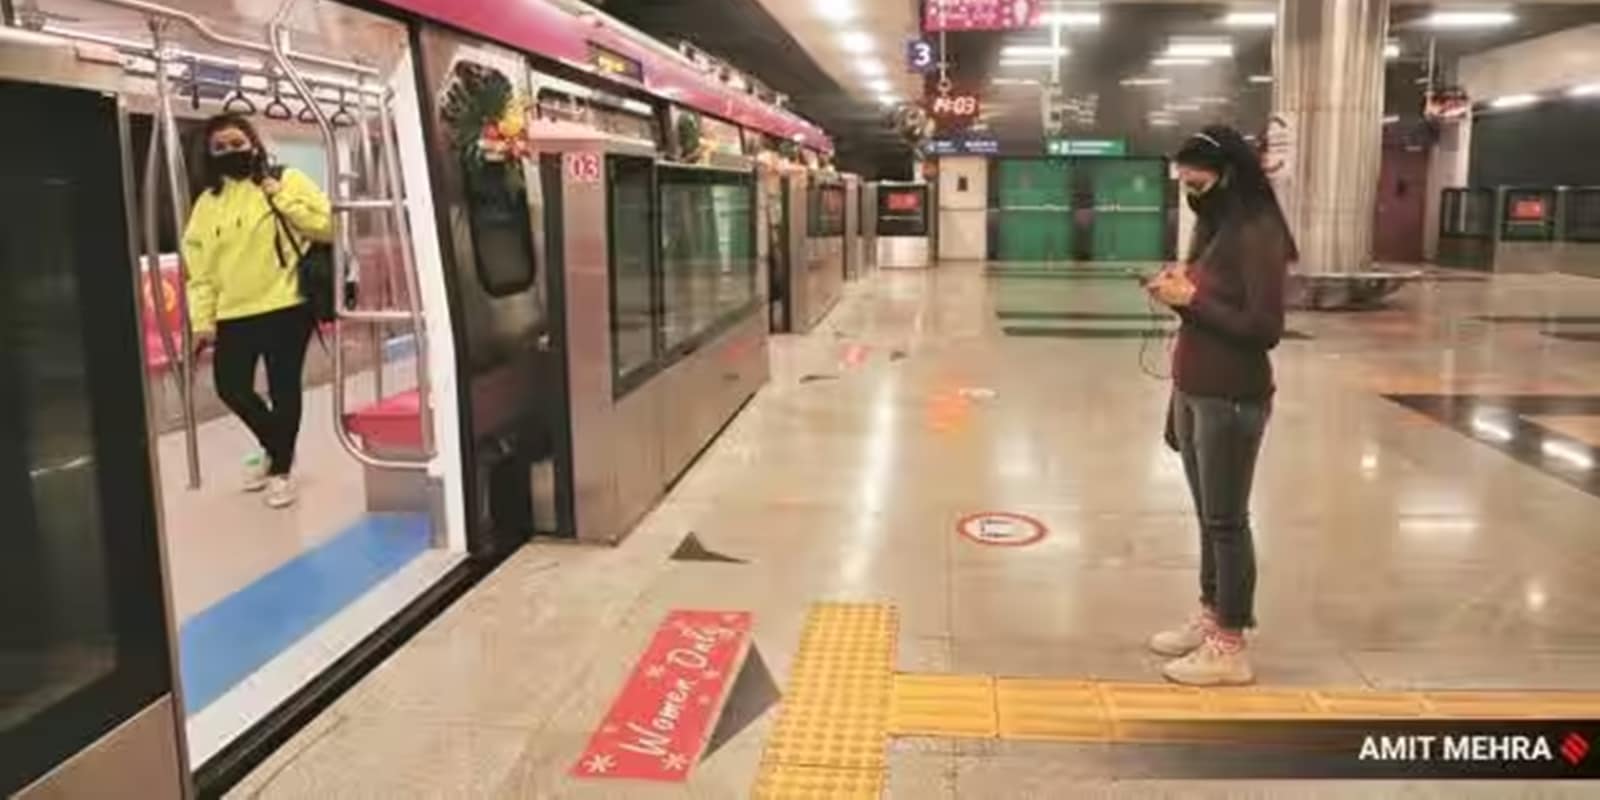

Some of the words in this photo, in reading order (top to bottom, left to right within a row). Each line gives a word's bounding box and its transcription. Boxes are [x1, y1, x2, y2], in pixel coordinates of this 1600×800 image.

[914, 43, 931, 66] 3
[570, 154, 598, 182] 03
[618, 677, 698, 757] Women
[666, 624, 736, 670] Only
